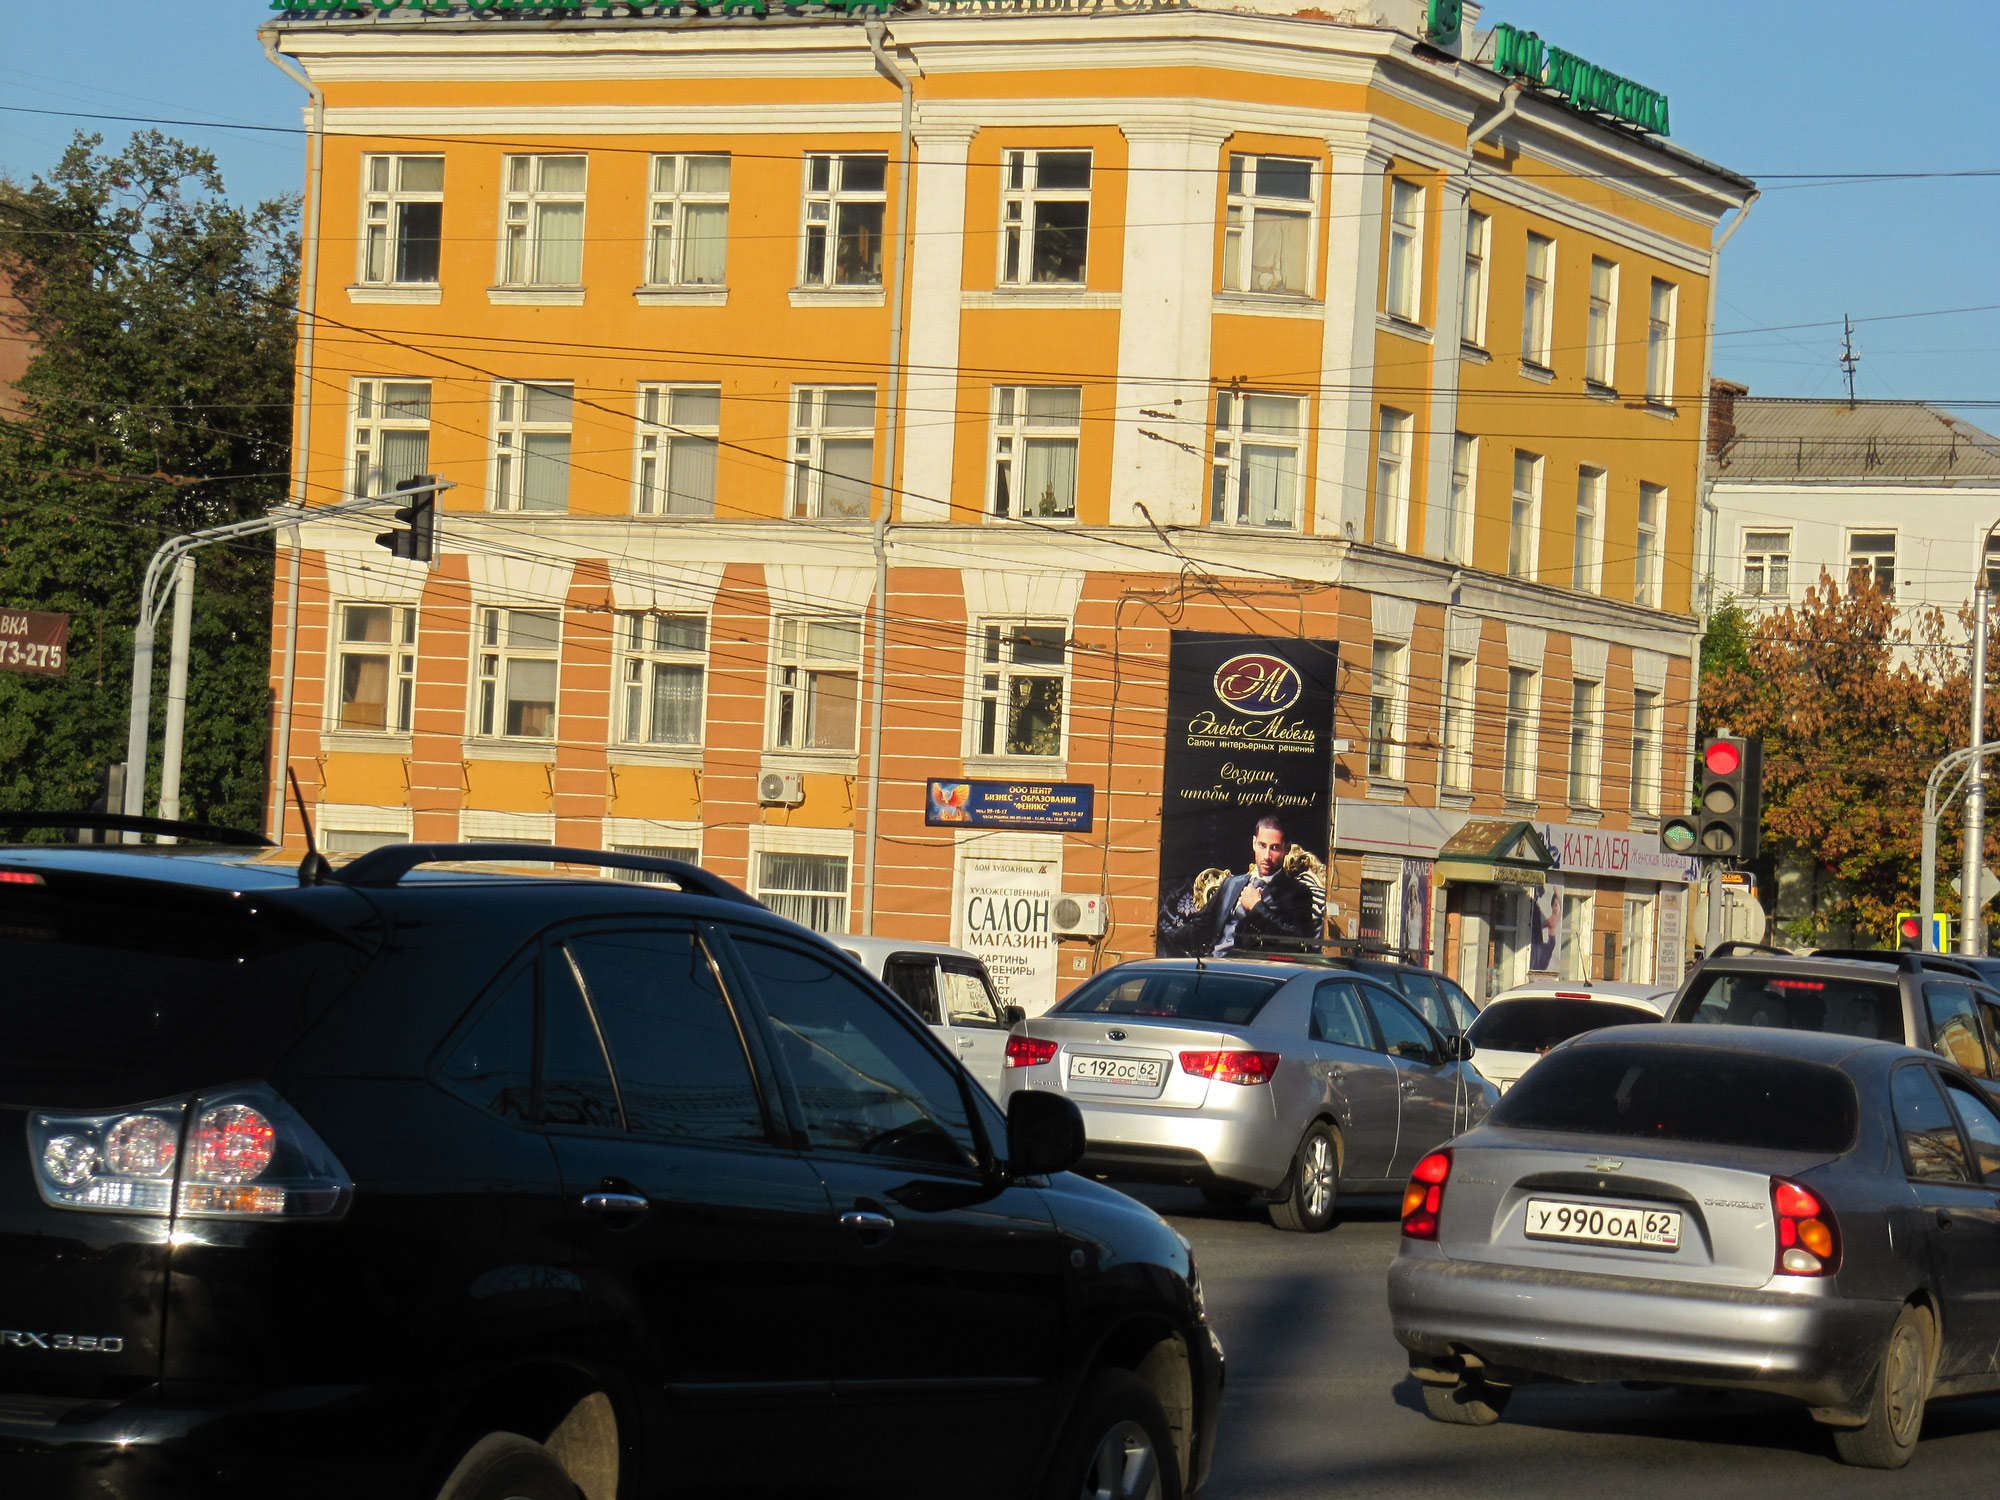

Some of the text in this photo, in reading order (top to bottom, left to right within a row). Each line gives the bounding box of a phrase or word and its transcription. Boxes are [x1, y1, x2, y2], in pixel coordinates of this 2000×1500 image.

[0, 640, 62, 669] 73-275
[1187, 737, 1315, 754] Салон интерьерных решений
[1220, 761, 1280, 786] Создан,
[1009, 786, 1053, 795] ООО ЦЕНТР
[1180, 784, 1317, 809] чтобы удивлять!
[984, 794, 1014, 802] БИЗНЕС
[1020, 795, 1077, 804] ОБРАЗОВАНИЯ
[1562, 832, 1630, 871] КАТАЛЕЯ
[974, 864, 1034, 874] ДОМ ХУДОЖНИКА
[1403, 860, 1434, 876] КАТАЛЕЯ
[970, 887, 1050, 898] ХУДОЖЕСТВЕННЫЙ
[968, 896, 1049, 933] САЛОН
[969, 932, 1048, 949] МАГАЗИН
[979, 953, 1028, 965] КАРТИНЫ
[986, 964, 1035, 976] УВЕНИРЫ
[1140, 1063, 1156, 1075] 62
[1645, 1214, 1671, 1234] 62
[1643, 1233, 1662, 1242] RUS
